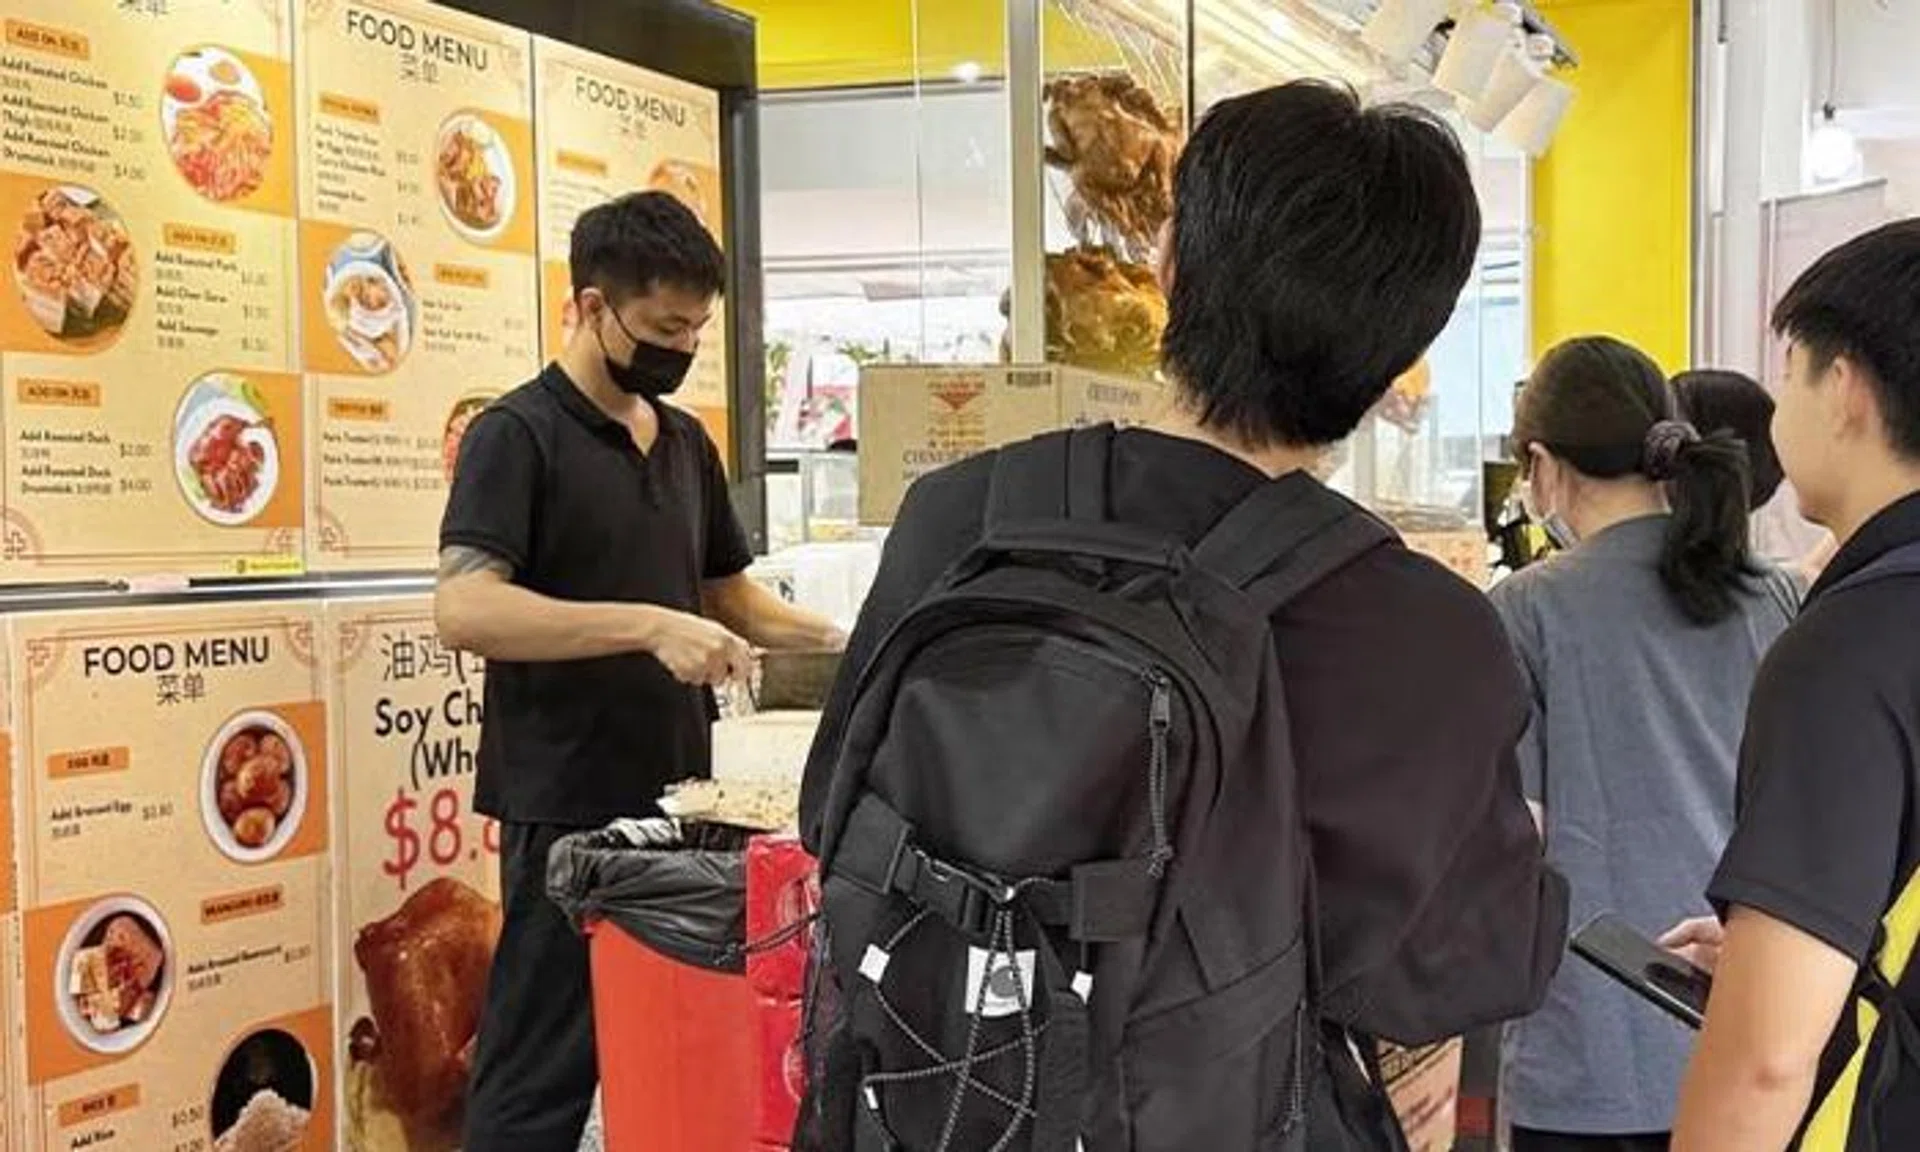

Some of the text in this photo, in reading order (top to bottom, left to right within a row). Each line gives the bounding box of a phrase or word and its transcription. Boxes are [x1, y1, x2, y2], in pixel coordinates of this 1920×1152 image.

[346, 9, 488, 72] FOOD MENU
[576, 75, 685, 128] FOOD MENU
[84, 636, 270, 678] FOOD MENU
[156, 672, 206, 706] 菜单
[374, 697, 434, 744] Soy
